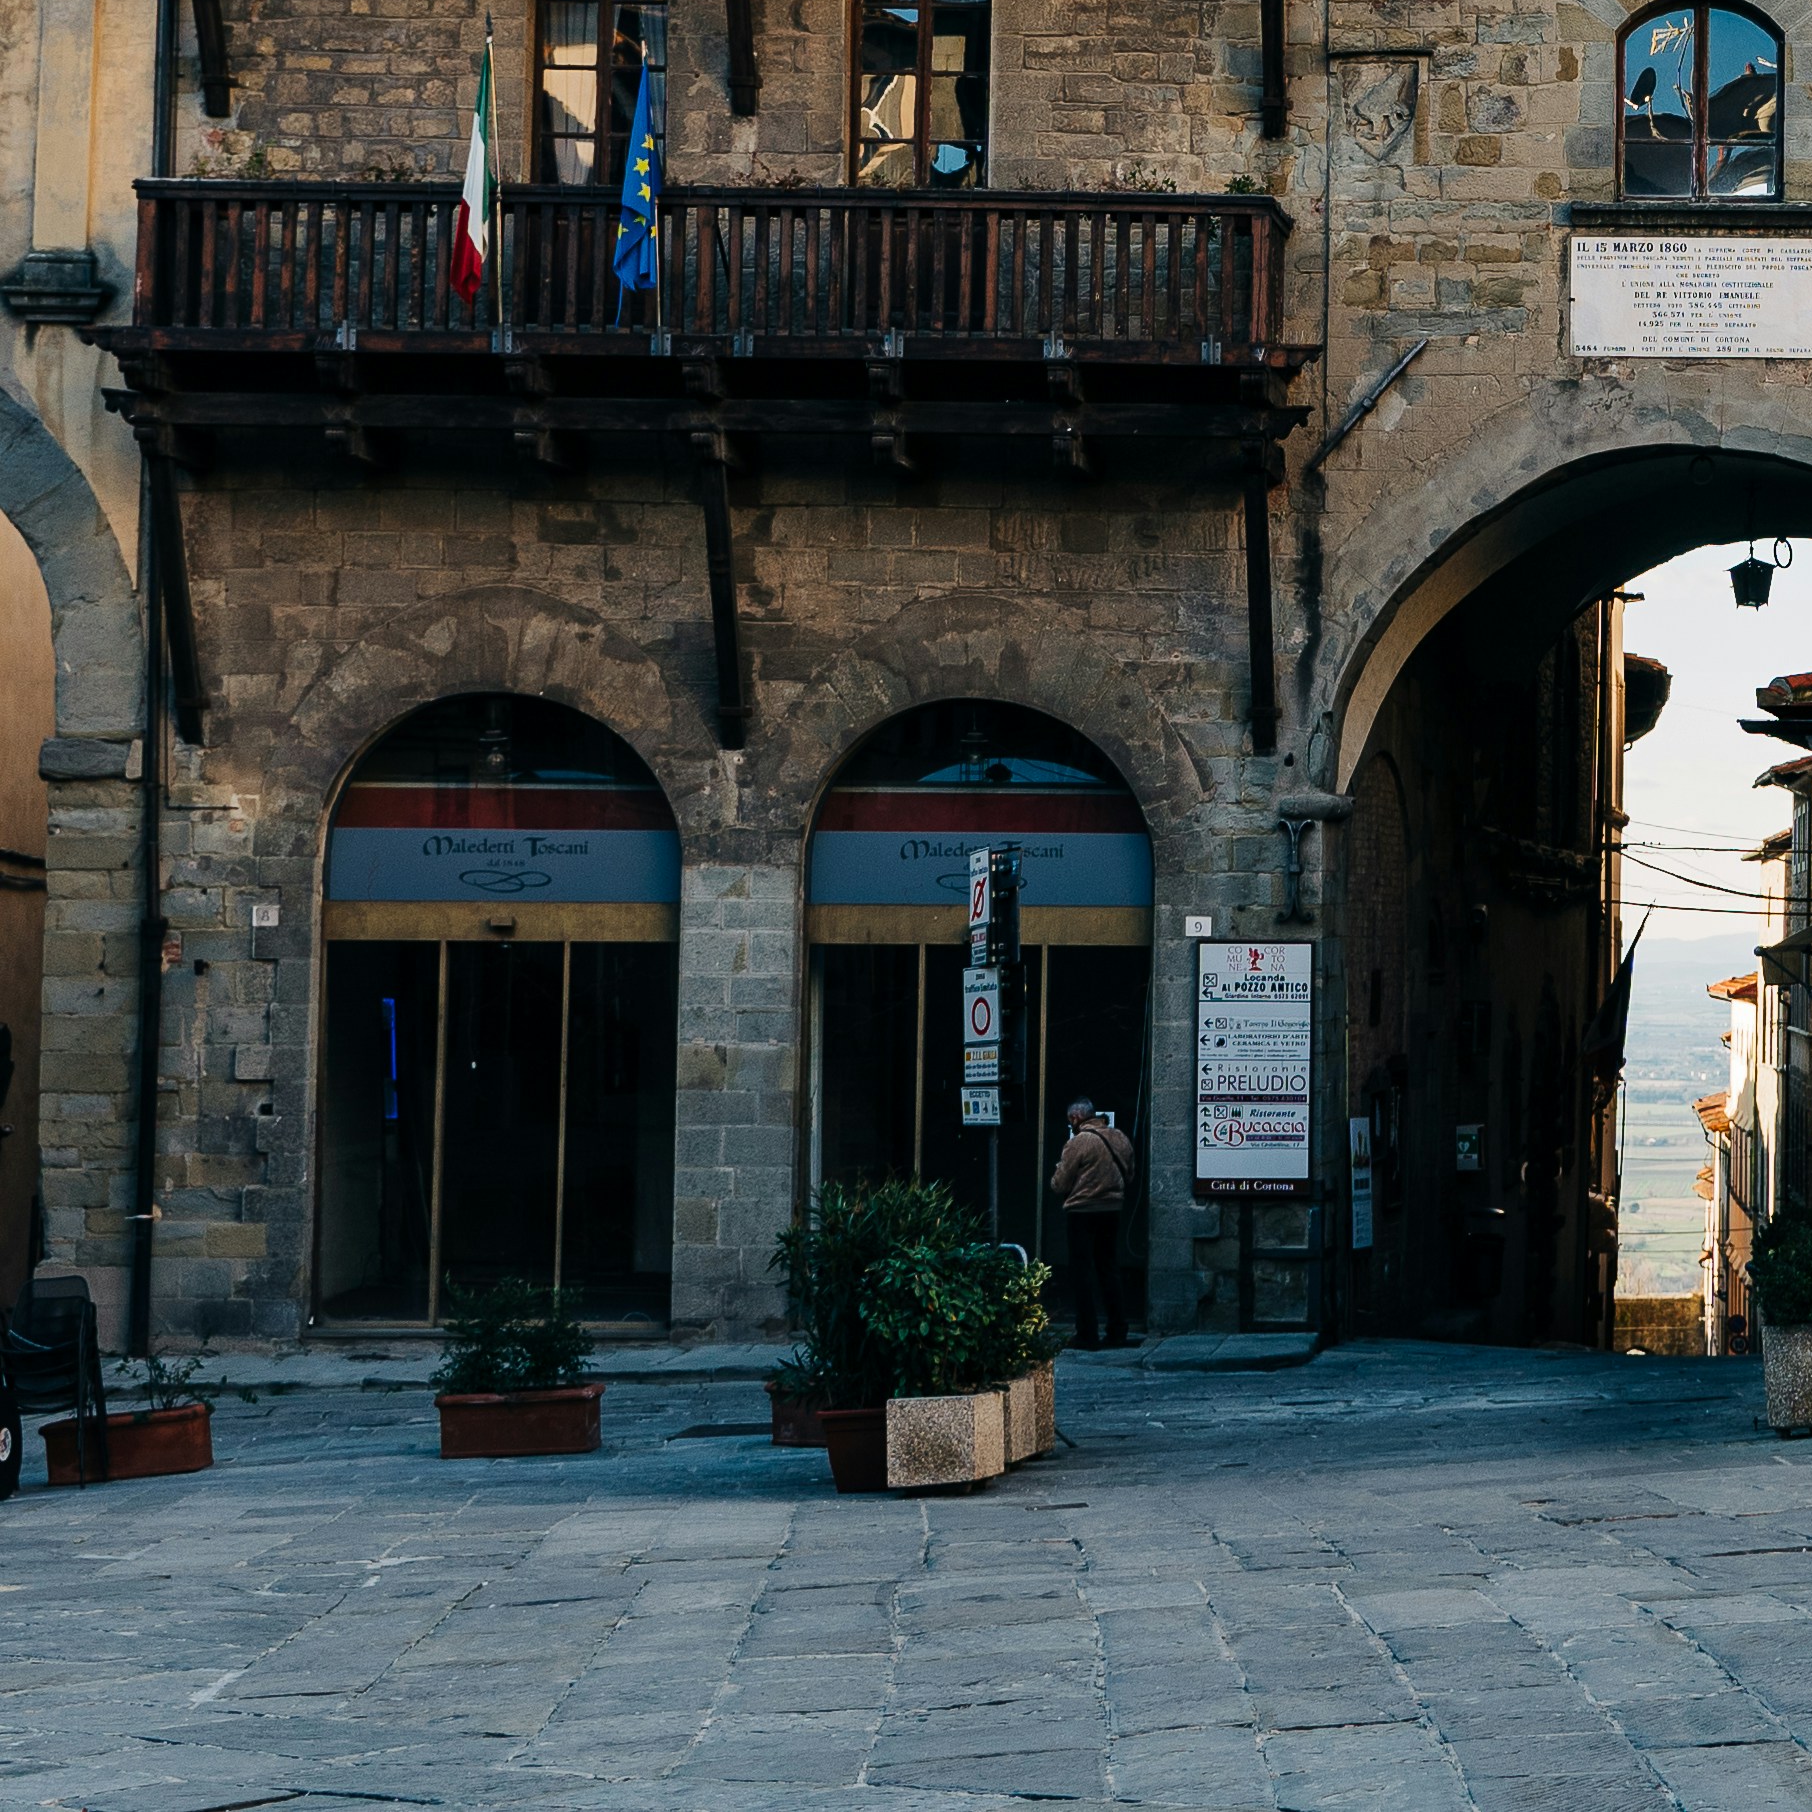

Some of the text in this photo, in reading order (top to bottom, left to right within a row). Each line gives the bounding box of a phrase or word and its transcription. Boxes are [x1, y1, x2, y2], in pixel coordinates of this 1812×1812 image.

[1577, 242, 1590, 252] IL
[1595, 242, 1608, 252] 15
[1613, 242, 1654, 253] MARZO
[1659, 242, 1688, 253] 1860
[423, 835, 588, 857] Maledetti Toscani
[901, 839, 989, 860] Malede
[261, 910, 270, 921] 8
[1194, 921, 1203, 933] 9
[1228, 946, 1286, 954] CO COR
[1227, 955, 1285, 963] MU TO
[1270, 964, 1285, 972] NA
[1244, 974, 1286, 982] Locanda
[1235, 982, 1266, 993] POZZO
[1270, 982, 1308, 993] ANTICO
[1217, 1064, 1307, 1073] Ristorante
[1217, 1075, 1306, 1091] PRELUDIO
[1249, 1109, 1296, 1118] Ristorante
[1211, 1180, 1294, 1190] Città di Cortona
